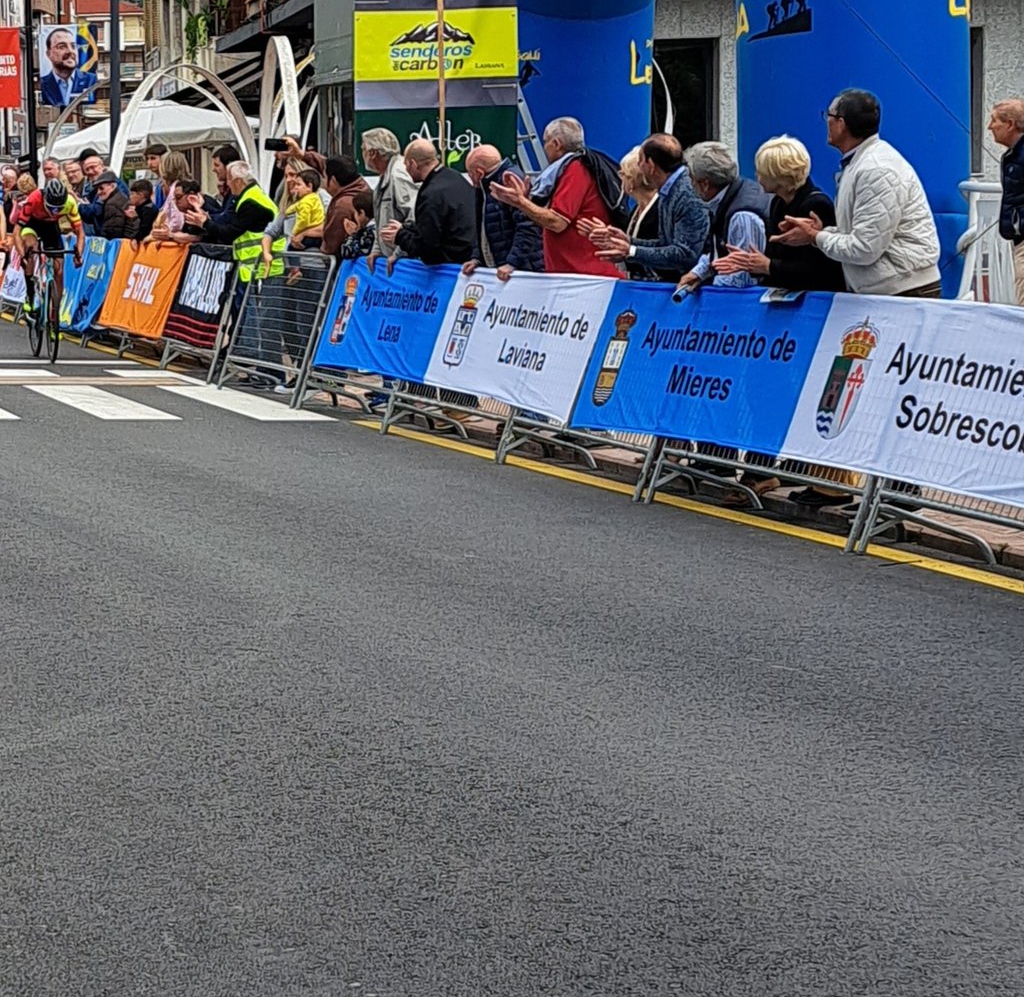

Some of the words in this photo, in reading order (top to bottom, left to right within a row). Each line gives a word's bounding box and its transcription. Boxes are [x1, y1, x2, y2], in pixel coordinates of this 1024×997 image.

[361, 284, 424, 312] Ayuntamiento
[423, 290, 439, 314] de
[377, 318, 401, 343] Lena
[483, 298, 570, 336] Ayuntamiento
[570, 313, 589, 341] de
[497, 338, 547, 372] Laviana
[641, 321, 766, 359] Ayuntamiento
[769, 330, 797, 362] de
[665, 364, 733, 401] Mieres
[885, 342, 1024, 397] Ayuntamie
[896, 394, 1024, 453] Sobresco
